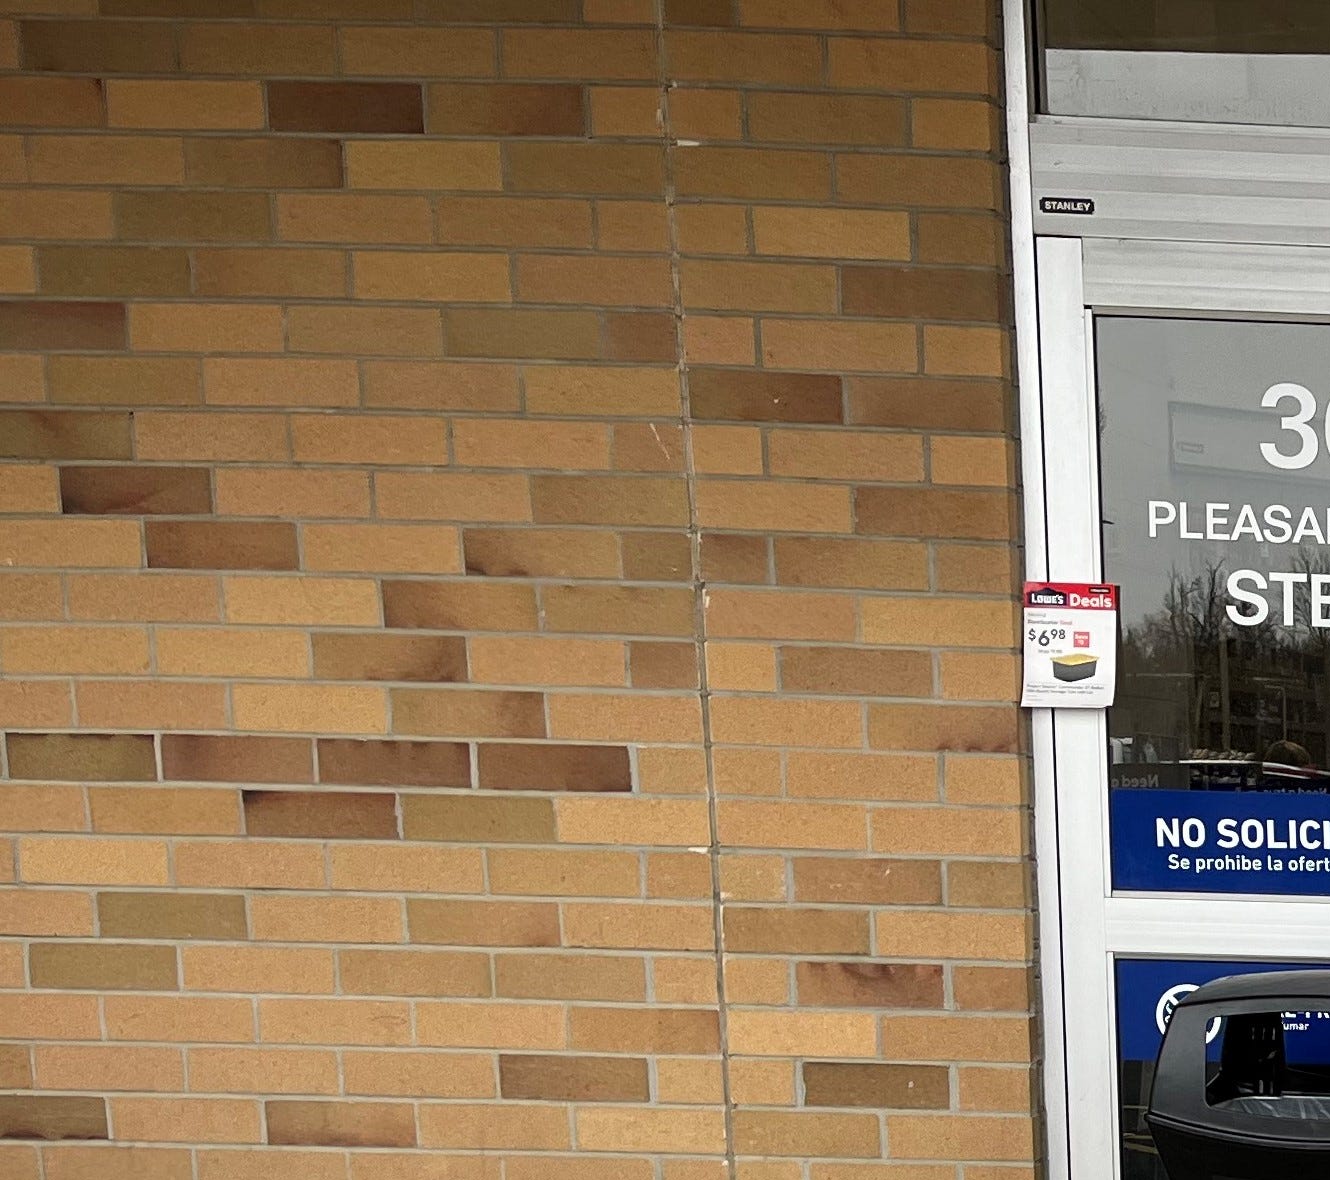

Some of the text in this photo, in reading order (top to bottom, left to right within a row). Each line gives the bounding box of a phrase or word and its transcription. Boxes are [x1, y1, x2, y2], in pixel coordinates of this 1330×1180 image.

[1044, 201, 1091, 211] STANLEY
[1031, 593, 1112, 608] LOWE'S Deals
[1155, 817, 1206, 848] NO
[1167, 854, 1190, 870] Se
[1196, 854, 1262, 874] prohibe
[1267, 855, 1283, 871] la
[1282, 1021, 1309, 1030] umar
